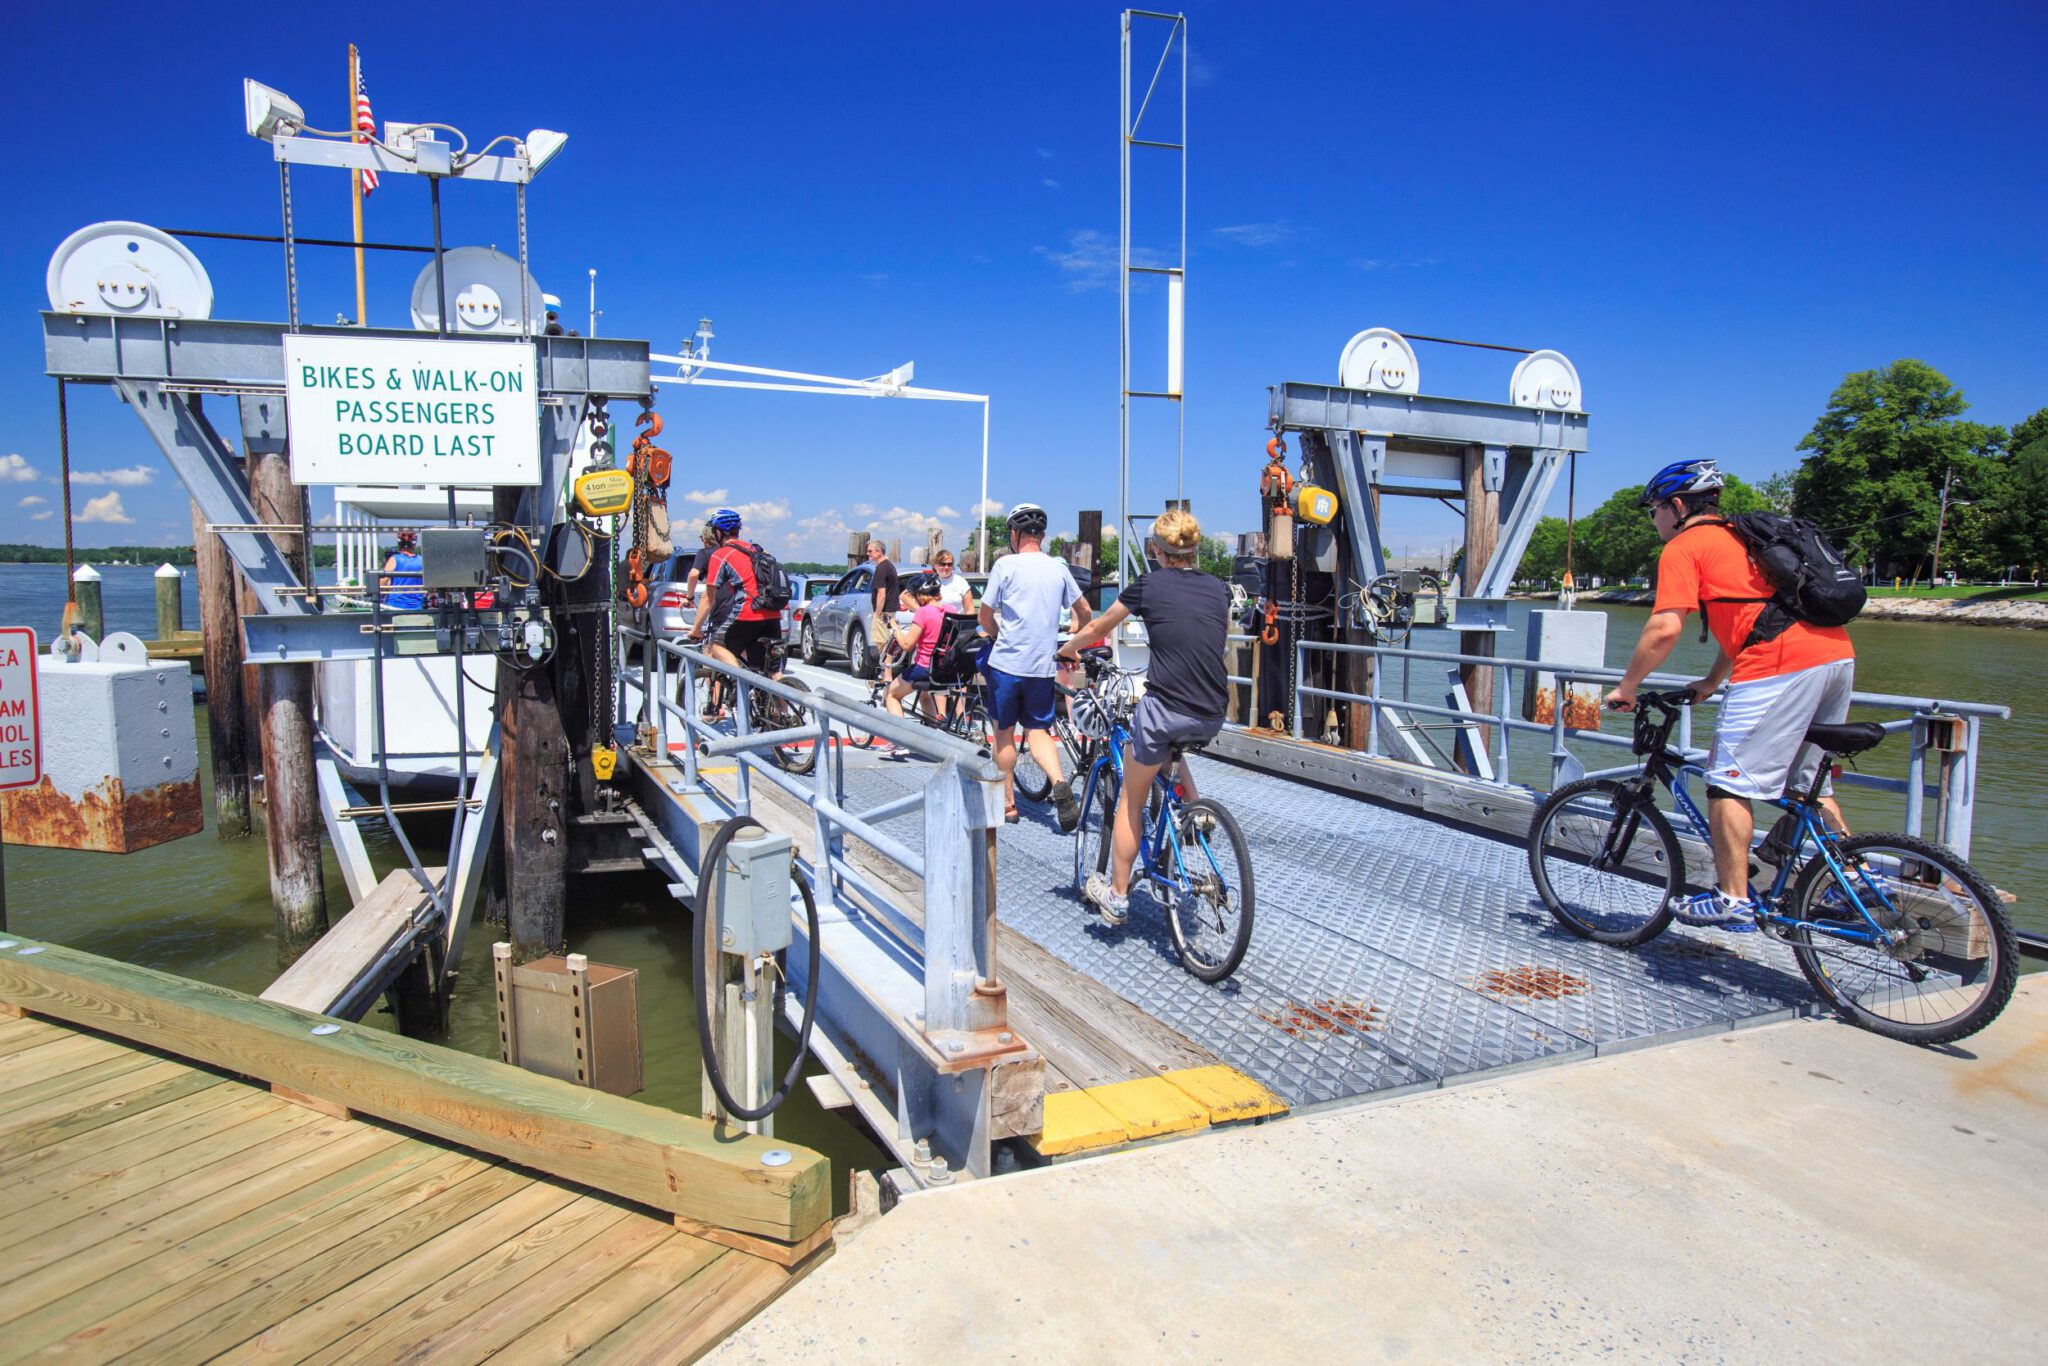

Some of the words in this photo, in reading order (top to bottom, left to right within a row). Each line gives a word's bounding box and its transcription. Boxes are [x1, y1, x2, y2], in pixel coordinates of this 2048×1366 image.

[302, 365, 376, 389] BIKES
[386, 368, 401, 391] &
[412, 369, 523, 393] WALK-ON
[336, 400, 495, 425] PASSENGERS
[338, 433, 424, 456] BOARD
[434, 435, 496, 457] LAST
[585, 483, 591, 491] 4
[592, 482, 606, 490] ton
[0, 724, 30, 744] OL
[0, 748, 33, 769] LES
